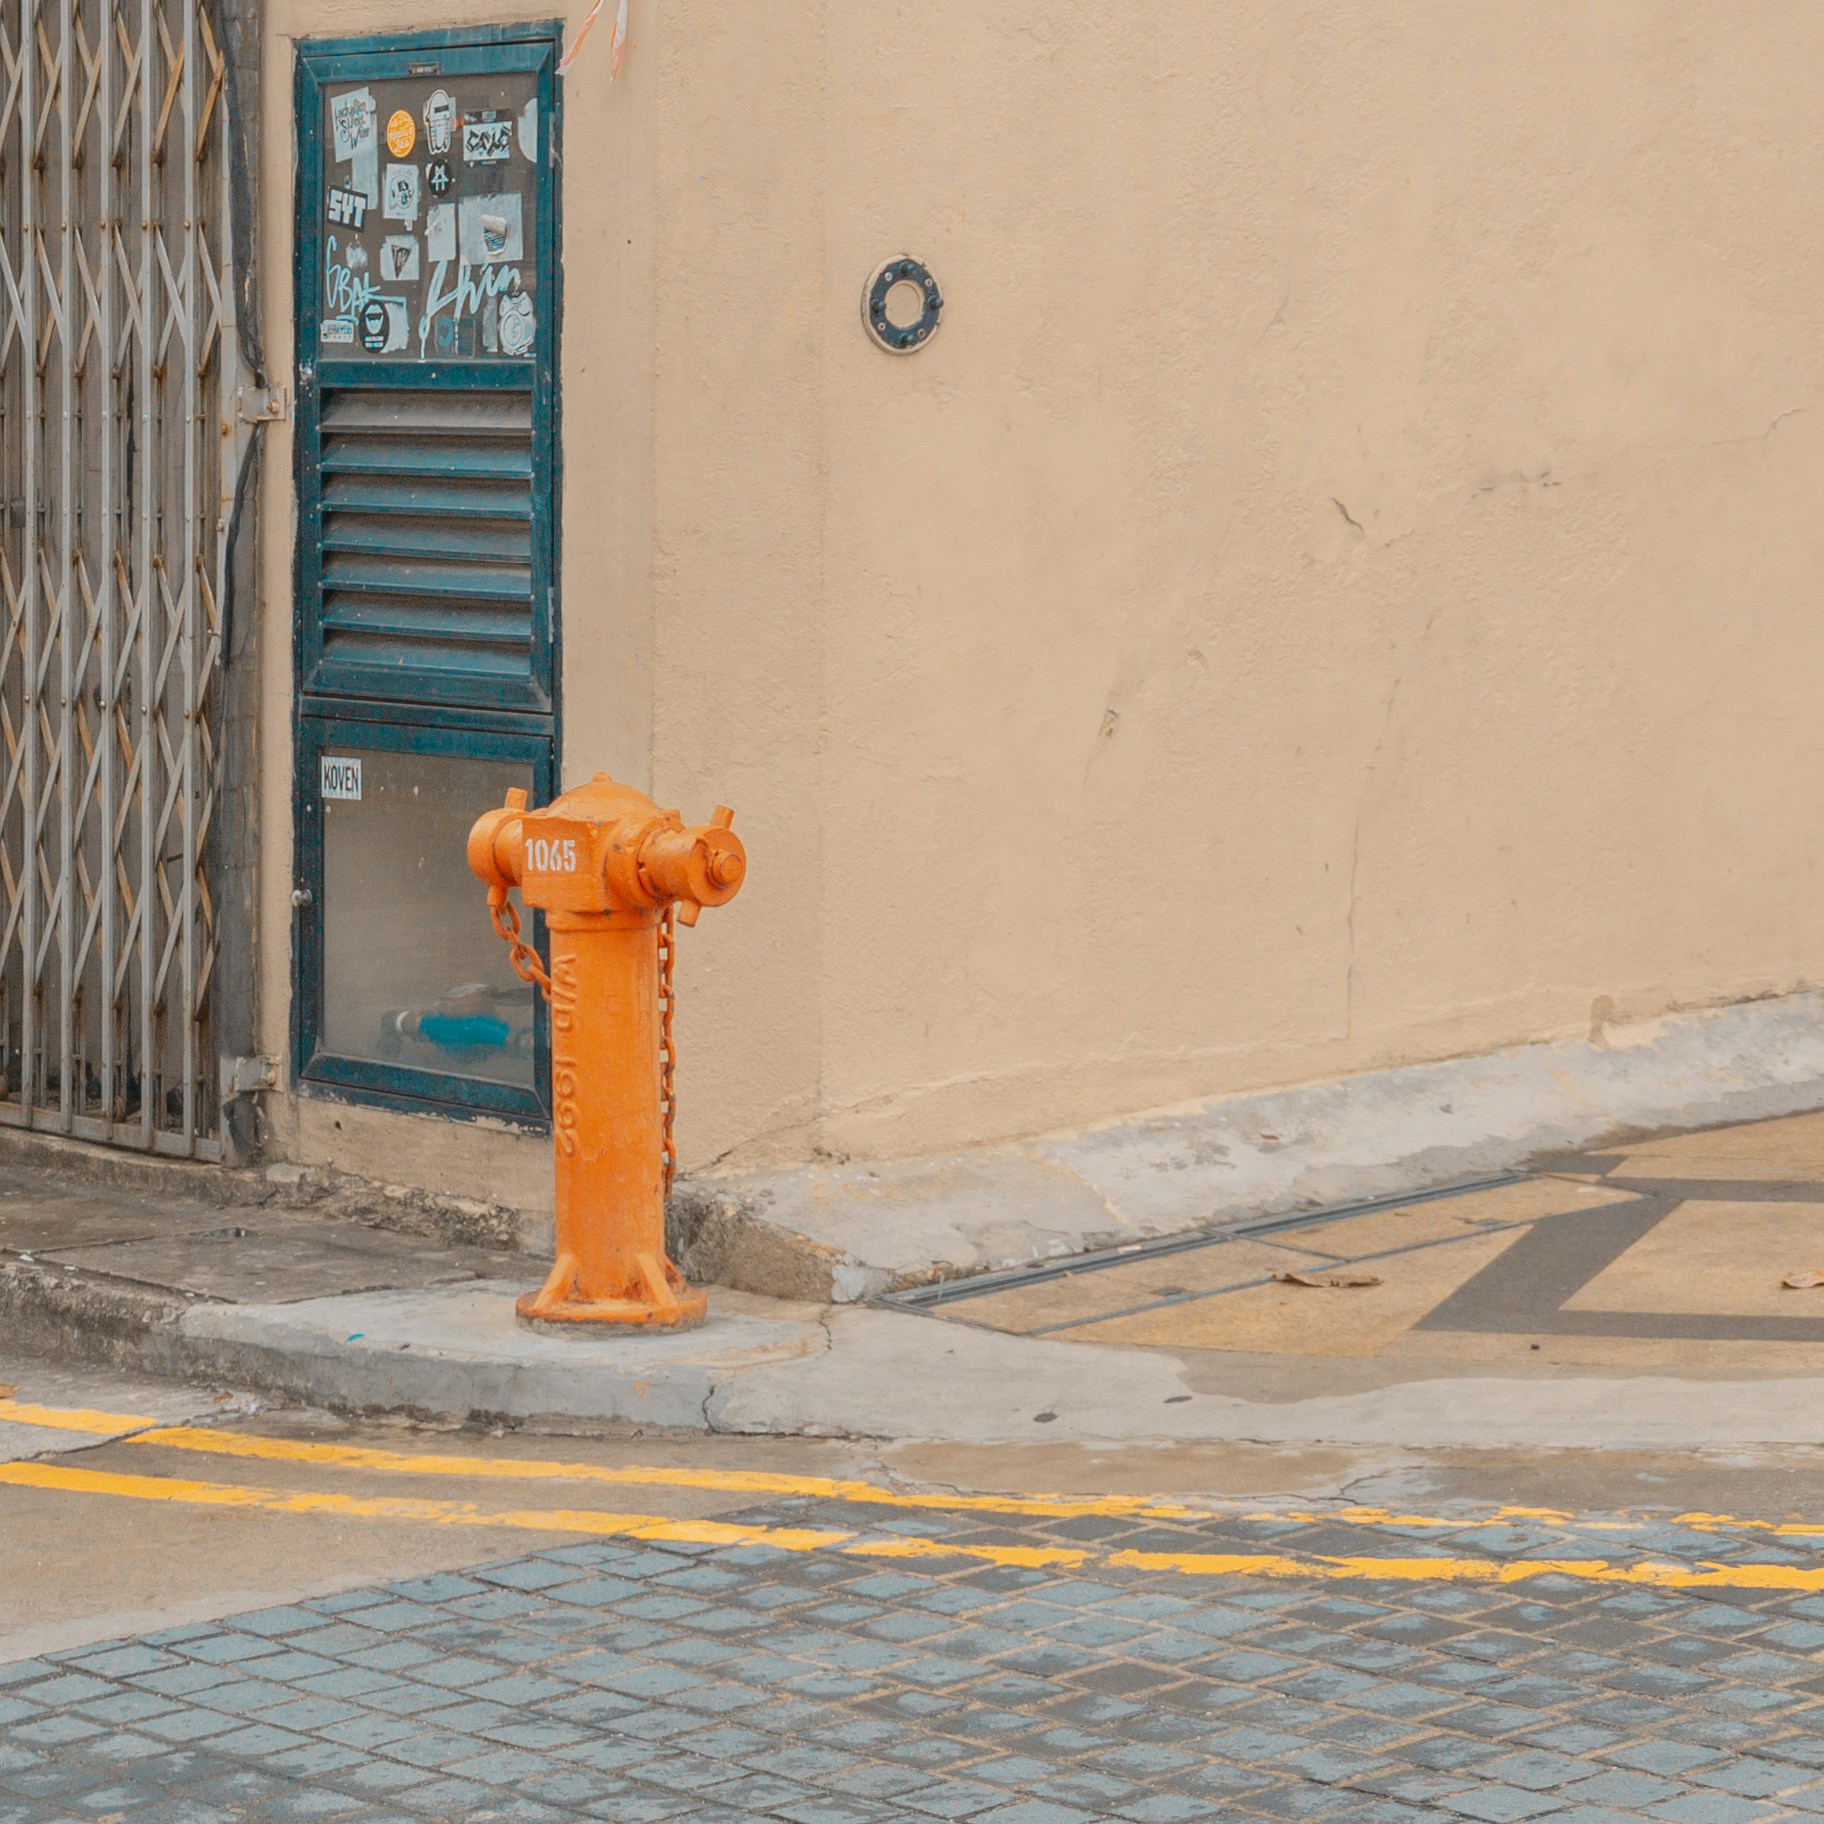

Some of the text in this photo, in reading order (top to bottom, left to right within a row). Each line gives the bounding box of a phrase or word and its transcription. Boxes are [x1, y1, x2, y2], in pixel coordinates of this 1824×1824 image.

[328, 188, 368, 228] SYT
[323, 764, 359, 792] KOVEN
[524, 838, 577, 872] 1065
[555, 1055, 578, 1155] 1992
